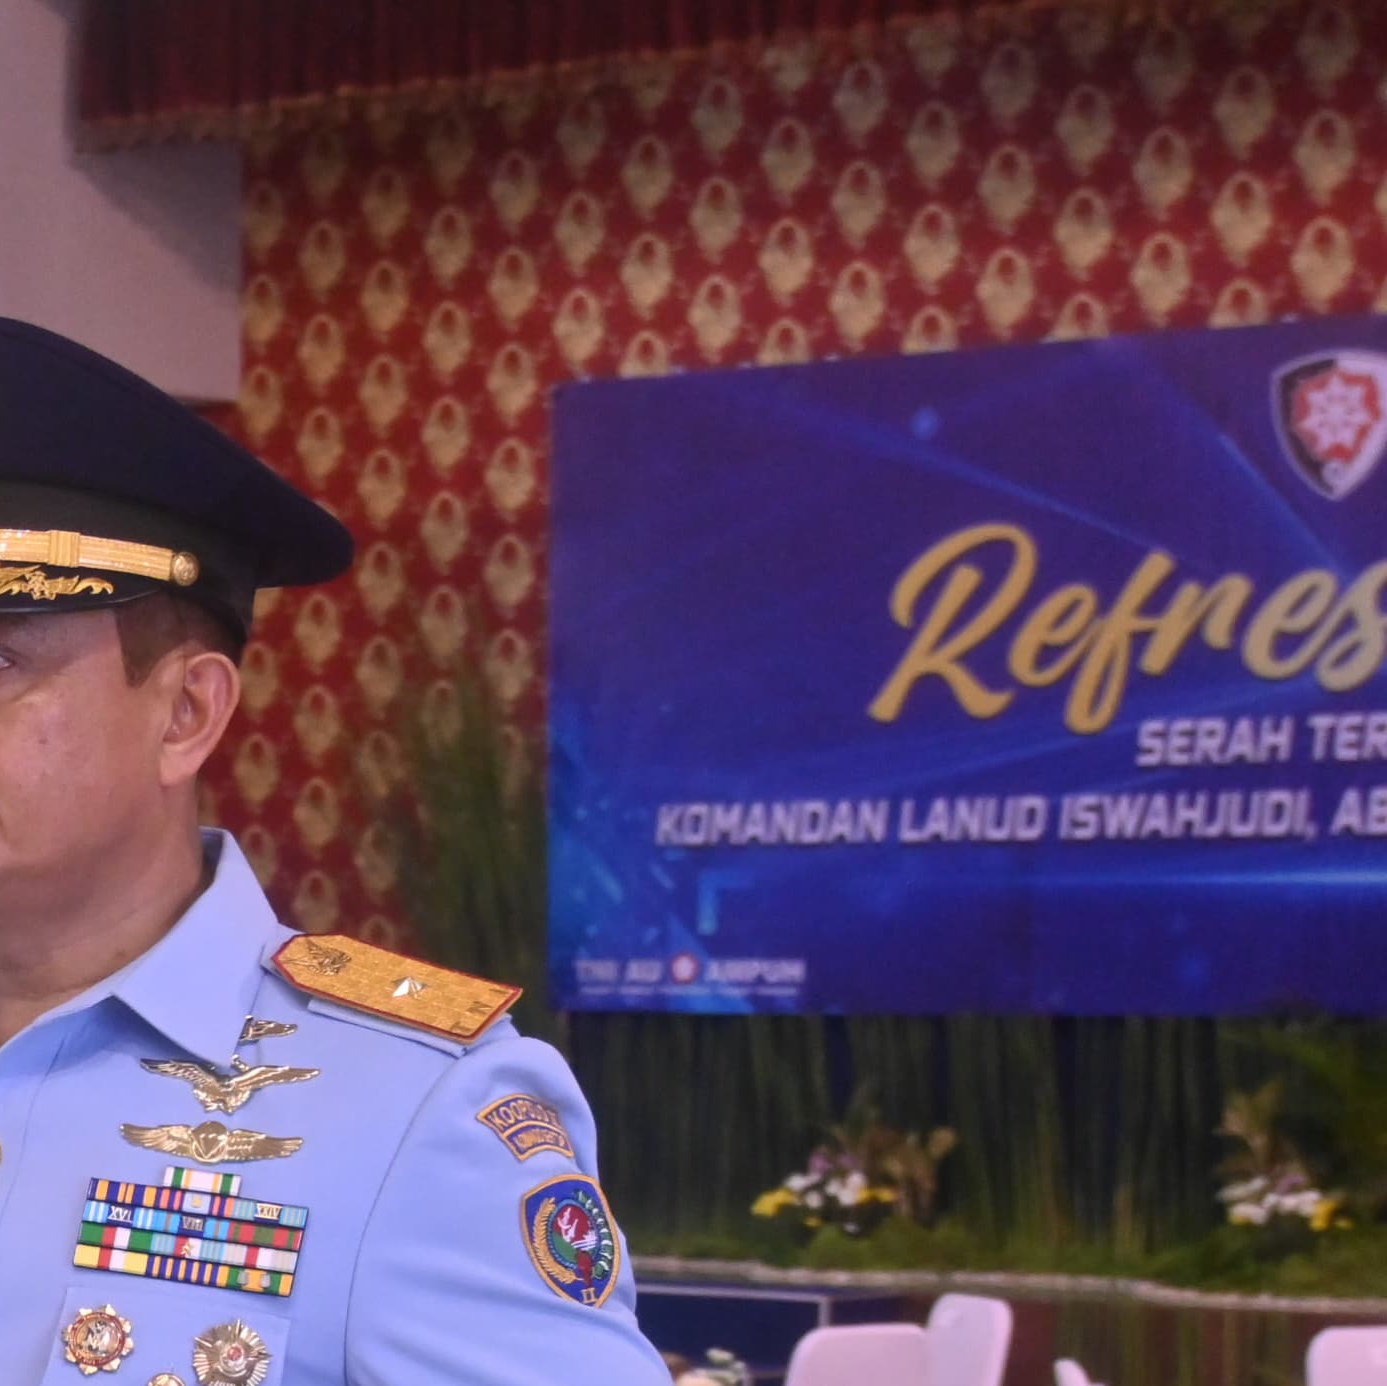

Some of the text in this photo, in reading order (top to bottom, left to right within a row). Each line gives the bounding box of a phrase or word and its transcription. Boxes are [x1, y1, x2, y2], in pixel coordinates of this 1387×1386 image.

[866, 522, 1387, 734] Refres
[1135, 712, 1387, 767] SERAH TER
[655, 799, 889, 845] KOMANDAN
[898, 795, 1049, 843] LANUD
[1059, 788, 1319, 842] ISWAHJUDI,
[107, 1205, 133, 1222] XVI
